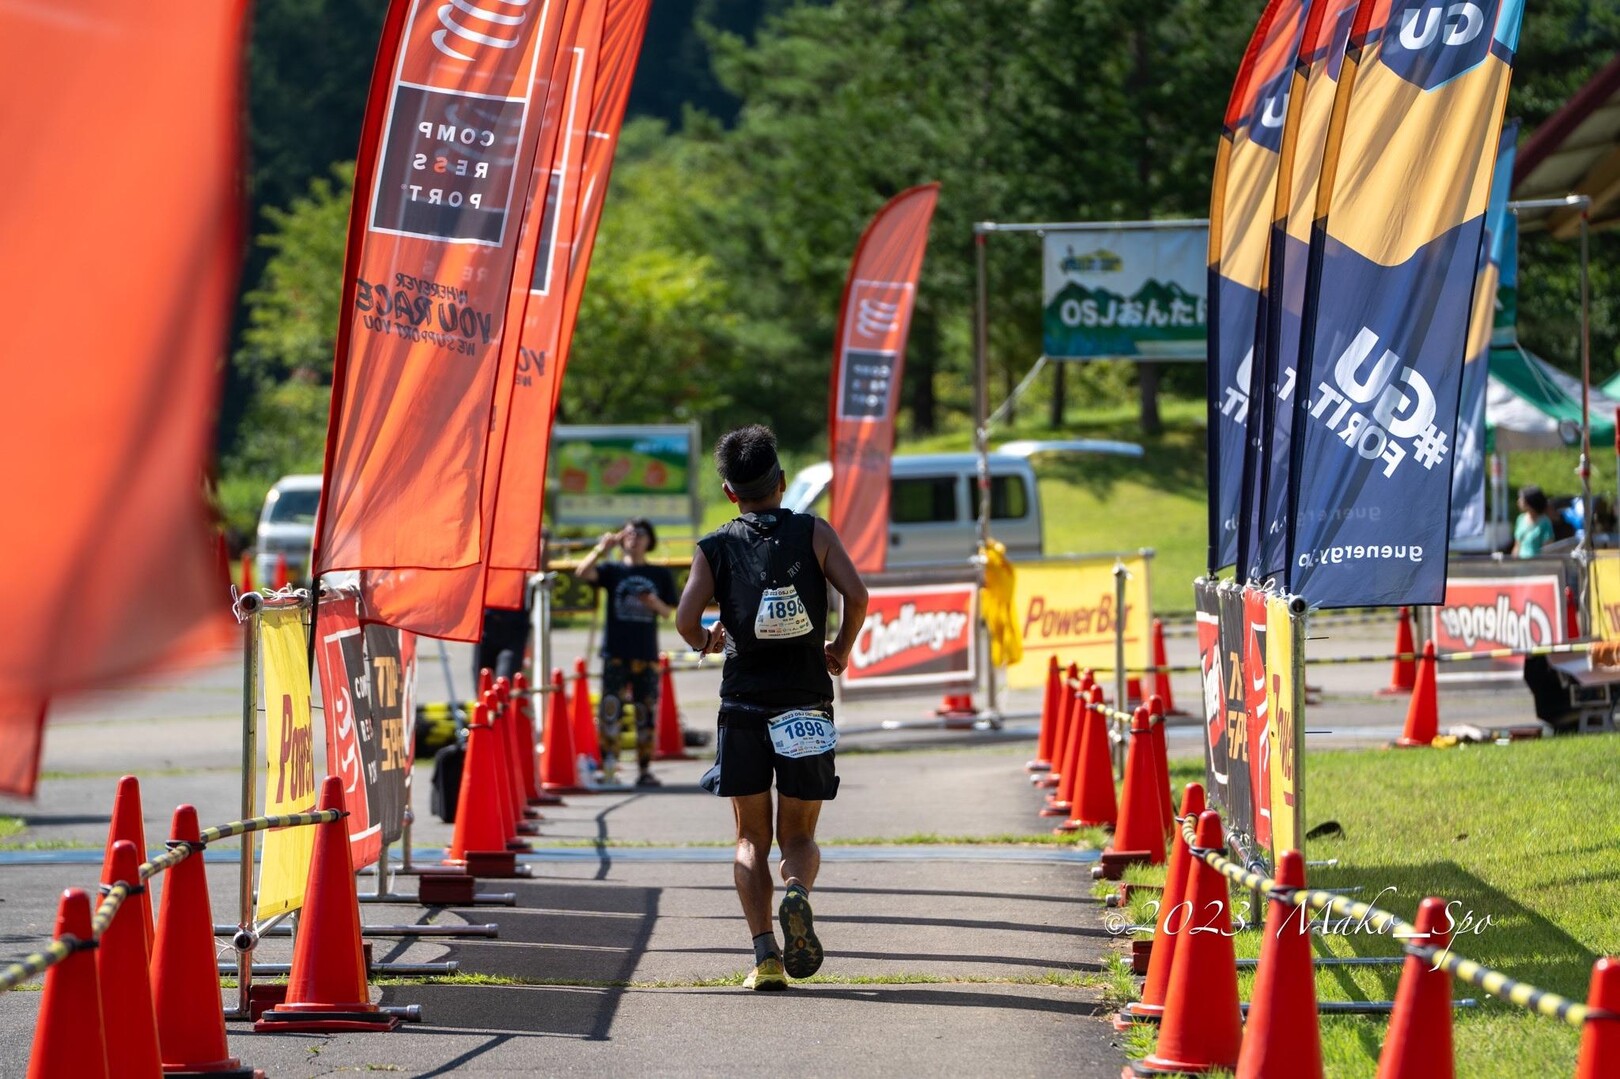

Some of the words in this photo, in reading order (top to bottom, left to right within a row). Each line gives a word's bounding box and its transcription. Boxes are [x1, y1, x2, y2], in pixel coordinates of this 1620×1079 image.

[767, 598, 804, 619] 1898
[1023, 594, 1133, 639] PowerBr
[851, 603, 968, 670] Challenger
[785, 720, 824, 740] 1898
